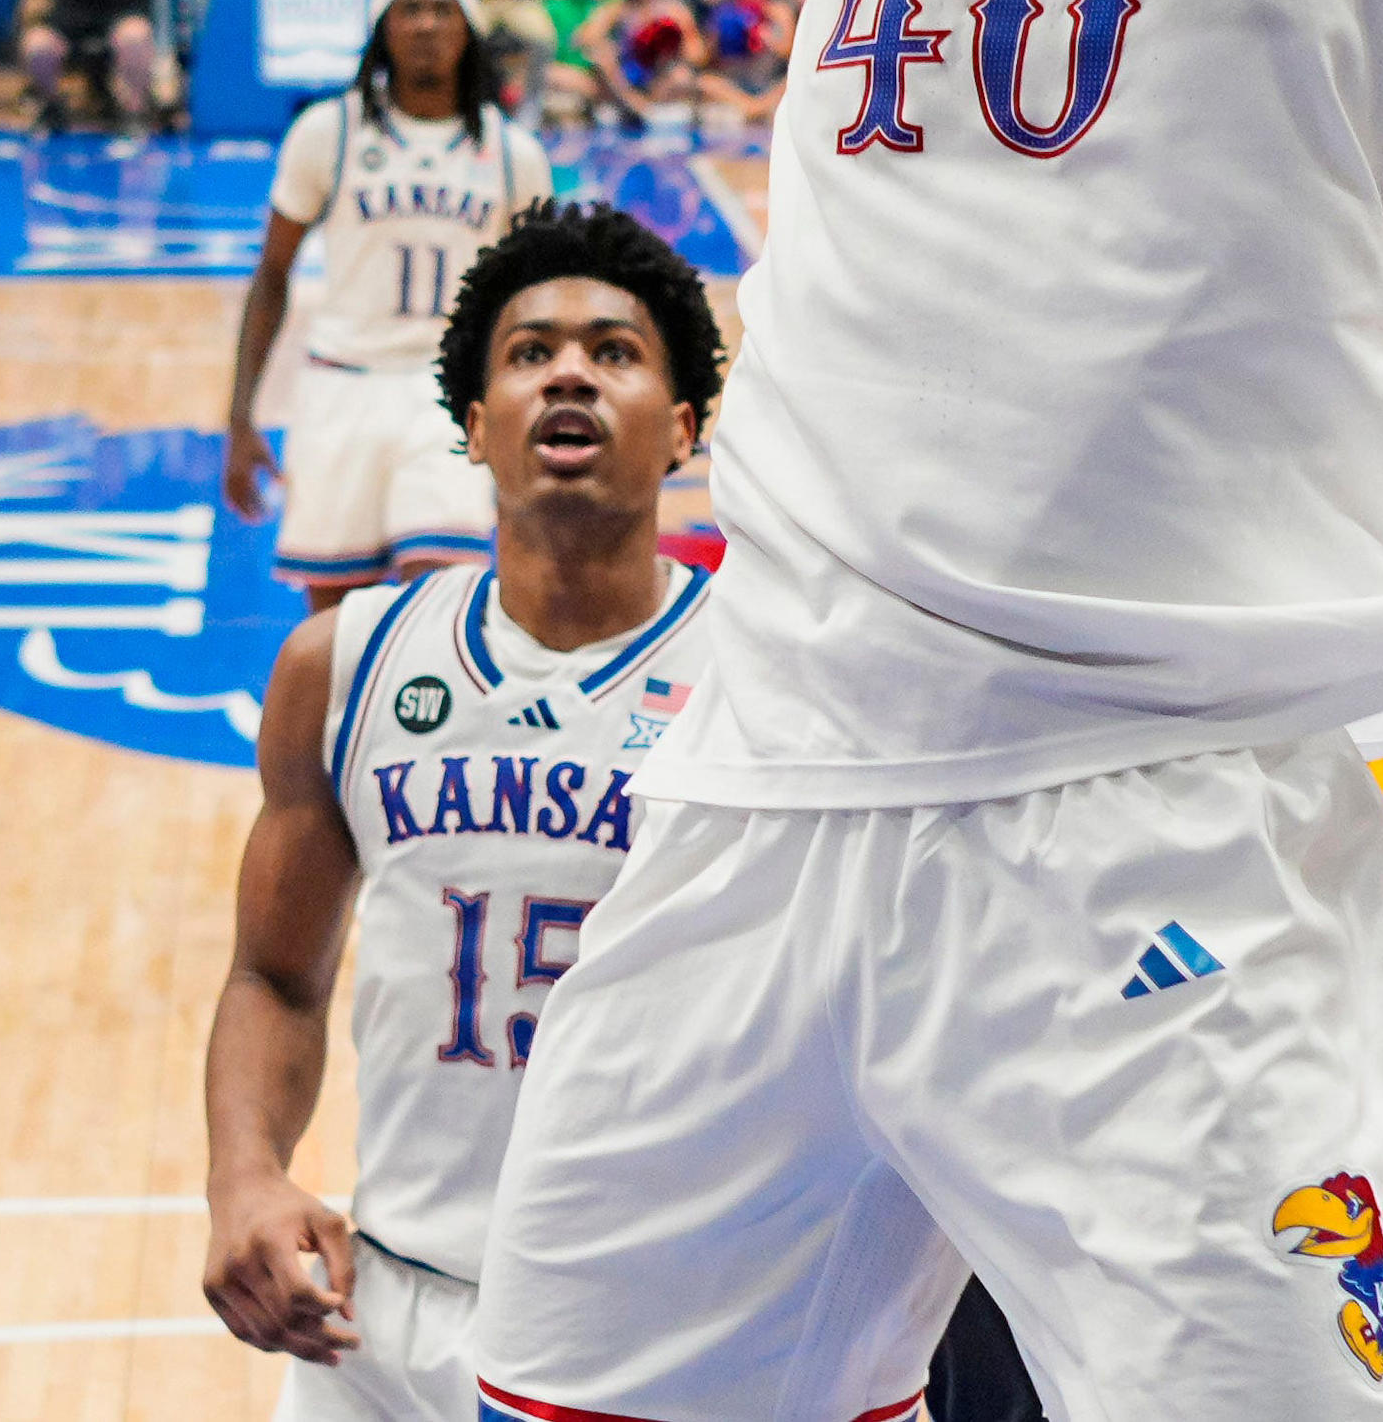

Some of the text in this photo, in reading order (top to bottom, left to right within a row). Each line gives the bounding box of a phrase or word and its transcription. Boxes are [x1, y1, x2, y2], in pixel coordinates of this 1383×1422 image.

[355, 182, 494, 231] KANSAS
[392, 239, 457, 318] 11
[398, 684, 447, 723] SW
[372, 754, 633, 854] KANSA
[437, 885, 599, 1071] 15
